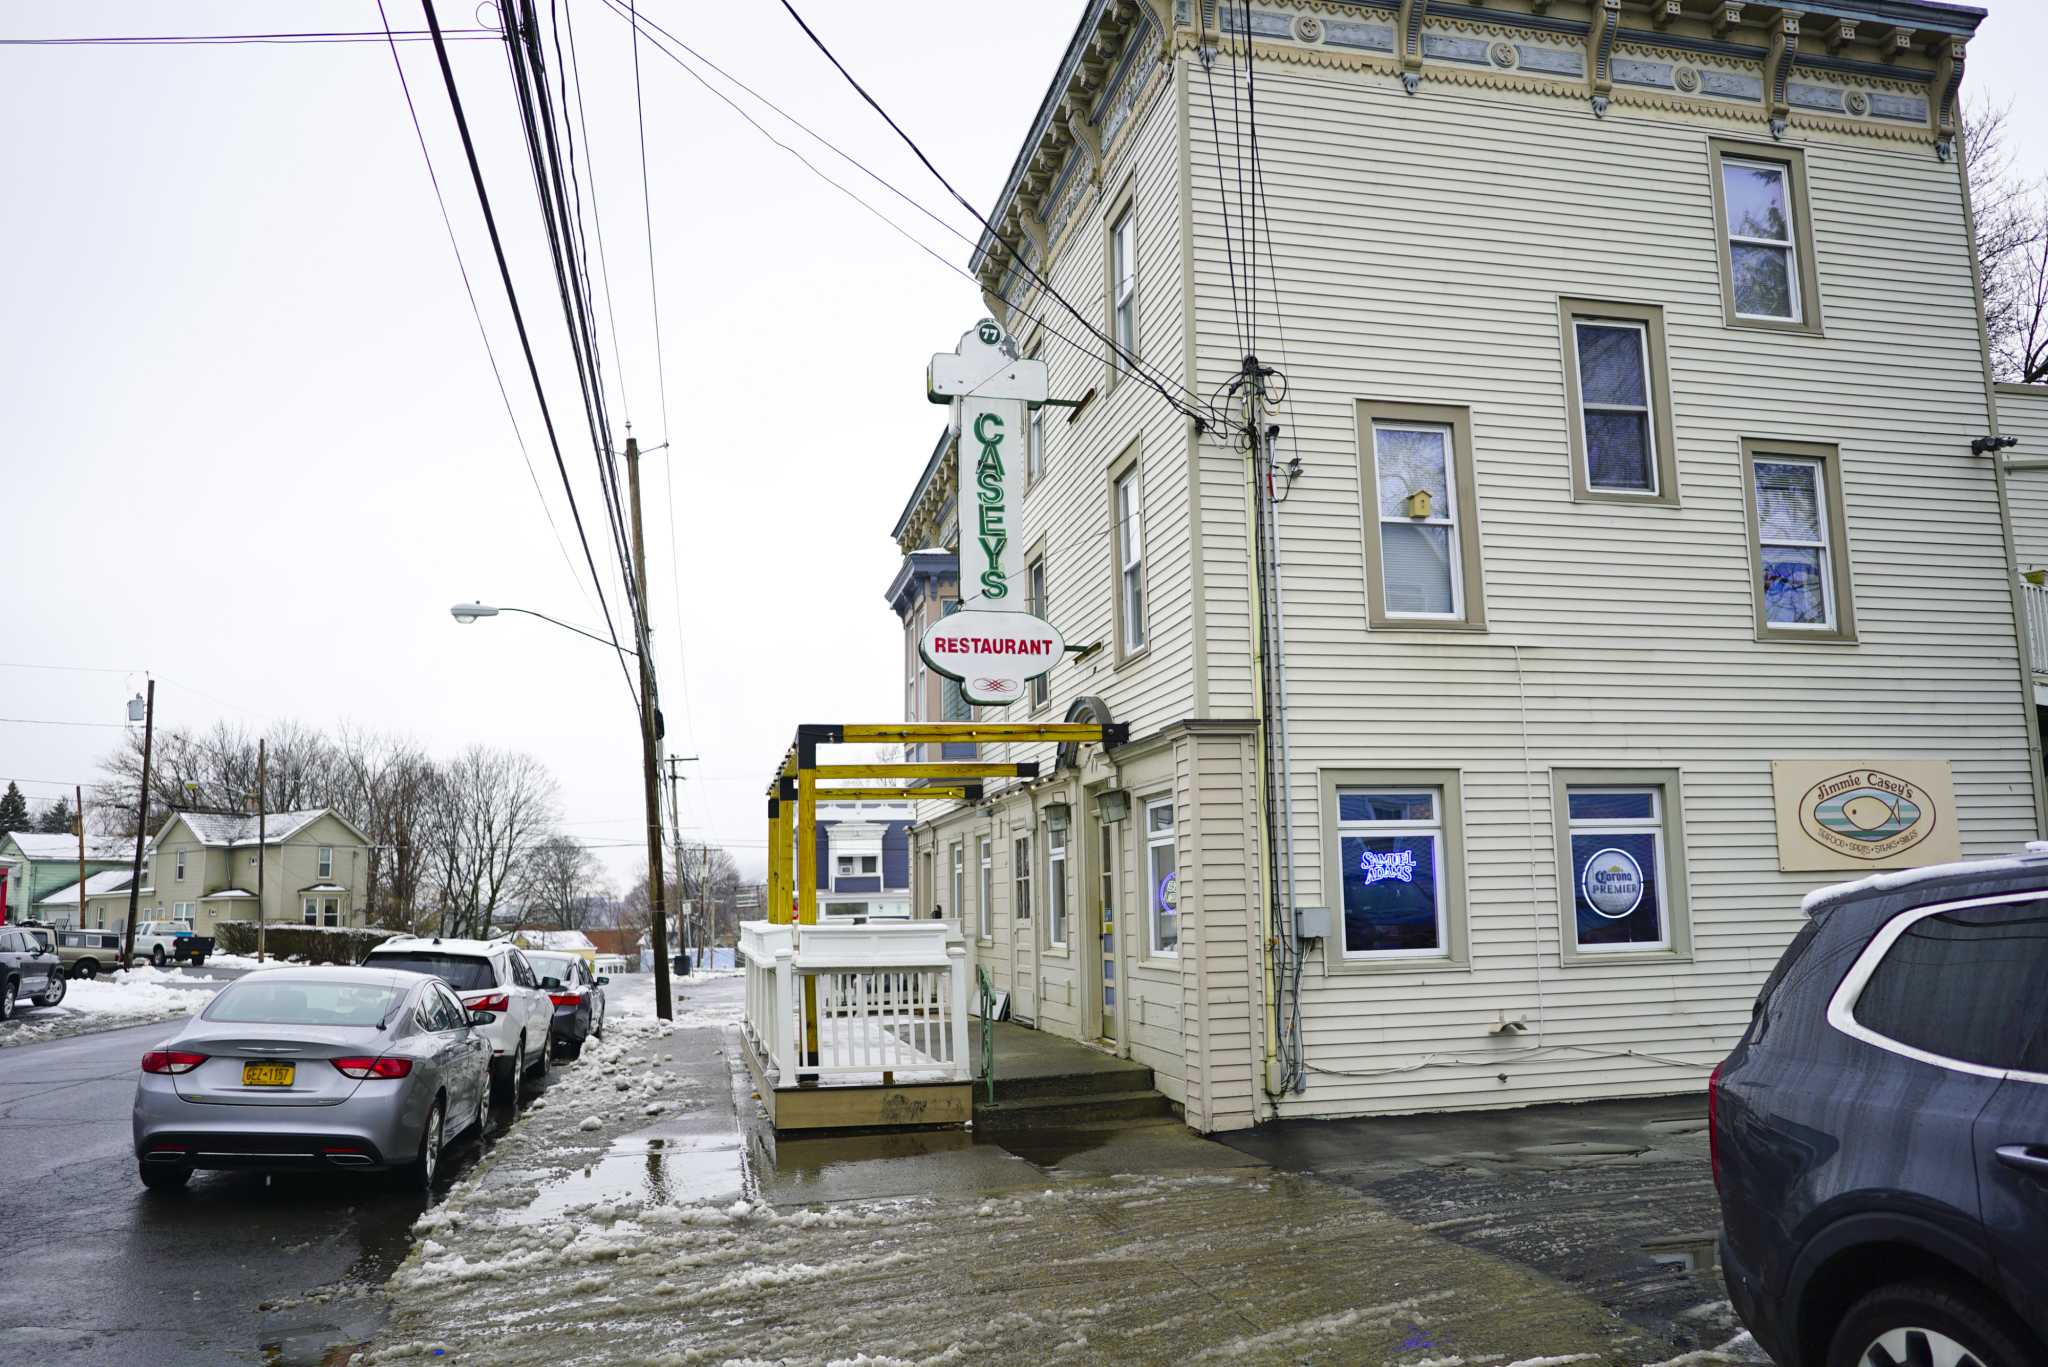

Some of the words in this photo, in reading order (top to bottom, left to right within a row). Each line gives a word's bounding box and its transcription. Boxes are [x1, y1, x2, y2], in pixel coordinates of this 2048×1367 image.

[981, 328, 998, 341] 77
[973, 412, 1008, 600] CASEYS
[934, 637, 1053, 656] RESTAURANT
[1817, 774, 1862, 801] Jimmie
[1866, 772, 1914, 799] Casey's
[1360, 849, 1416, 870] SAMUEL
[1364, 865, 1413, 885] ADAMS
[1594, 870, 1633, 885] Corona
[1592, 884, 1638, 895] PREMIER
